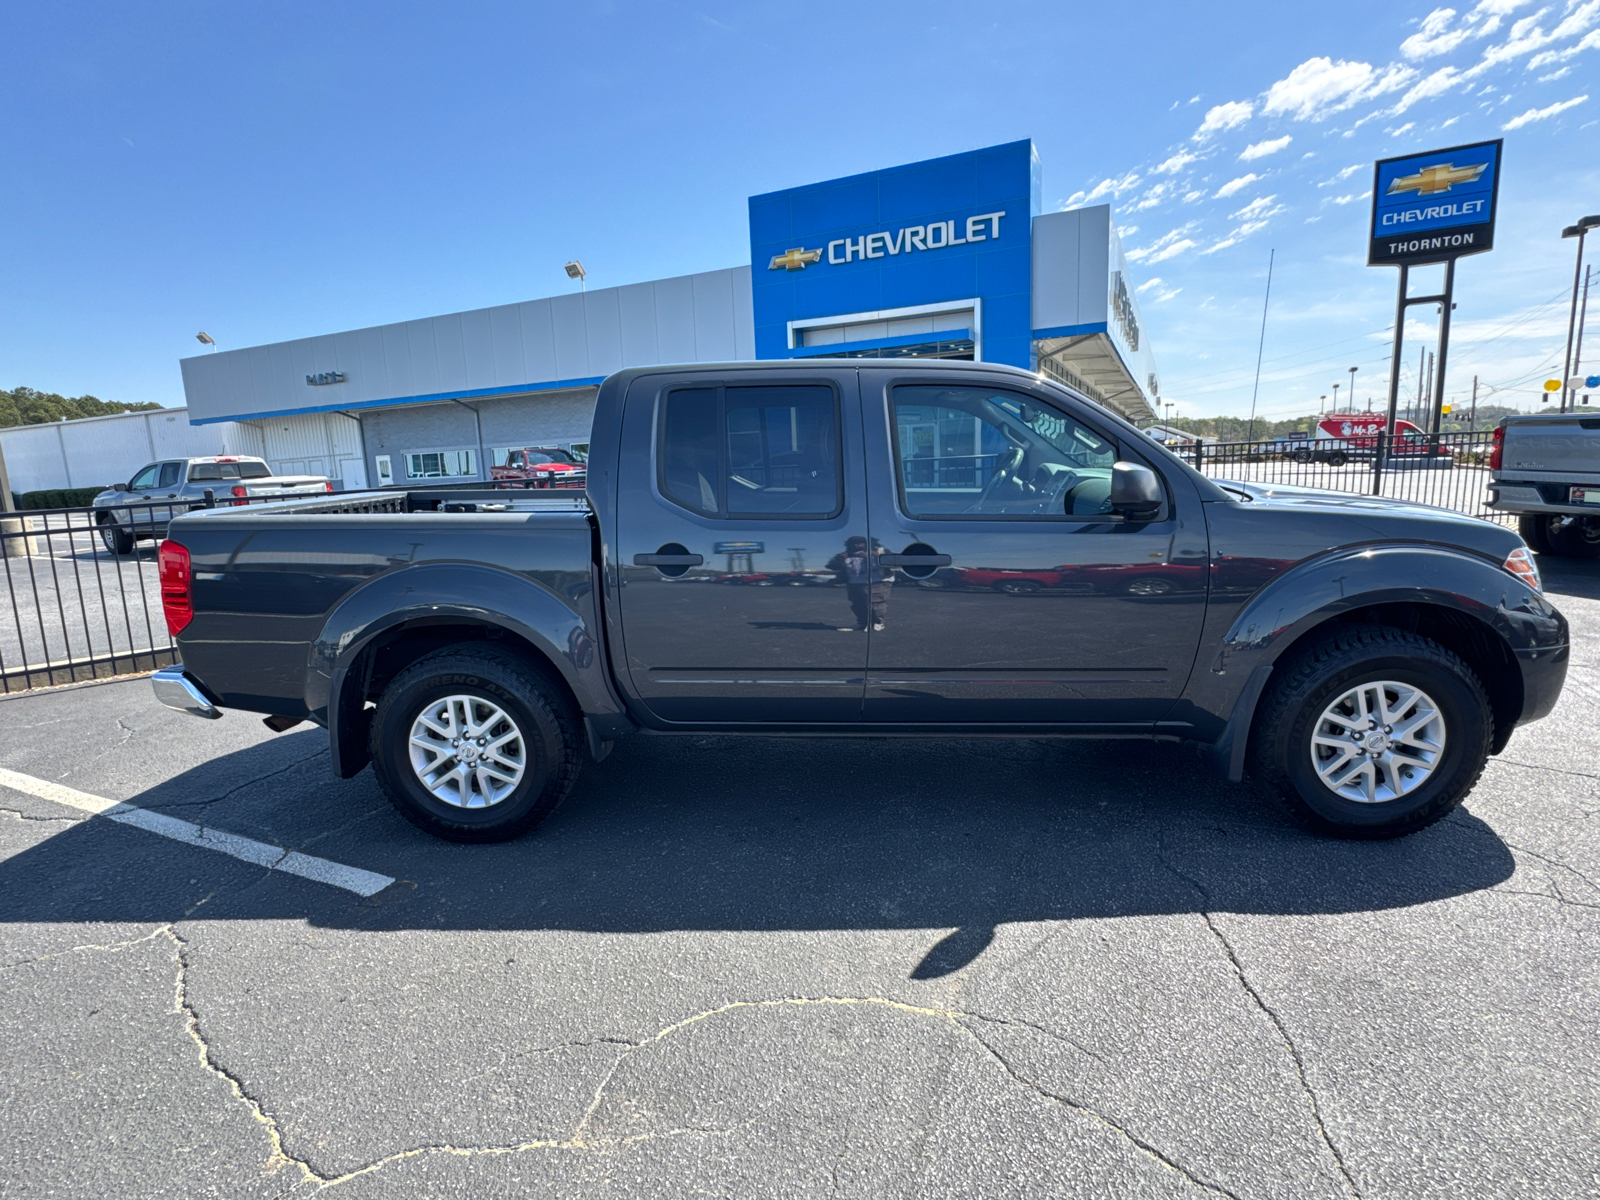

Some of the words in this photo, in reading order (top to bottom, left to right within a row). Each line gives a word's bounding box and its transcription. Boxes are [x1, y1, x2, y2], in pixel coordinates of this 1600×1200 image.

[1382, 200, 1484, 225] CHEVROLET
[827, 211, 1006, 265] CHEVROLET
[1389, 233, 1474, 253] THORNTON
